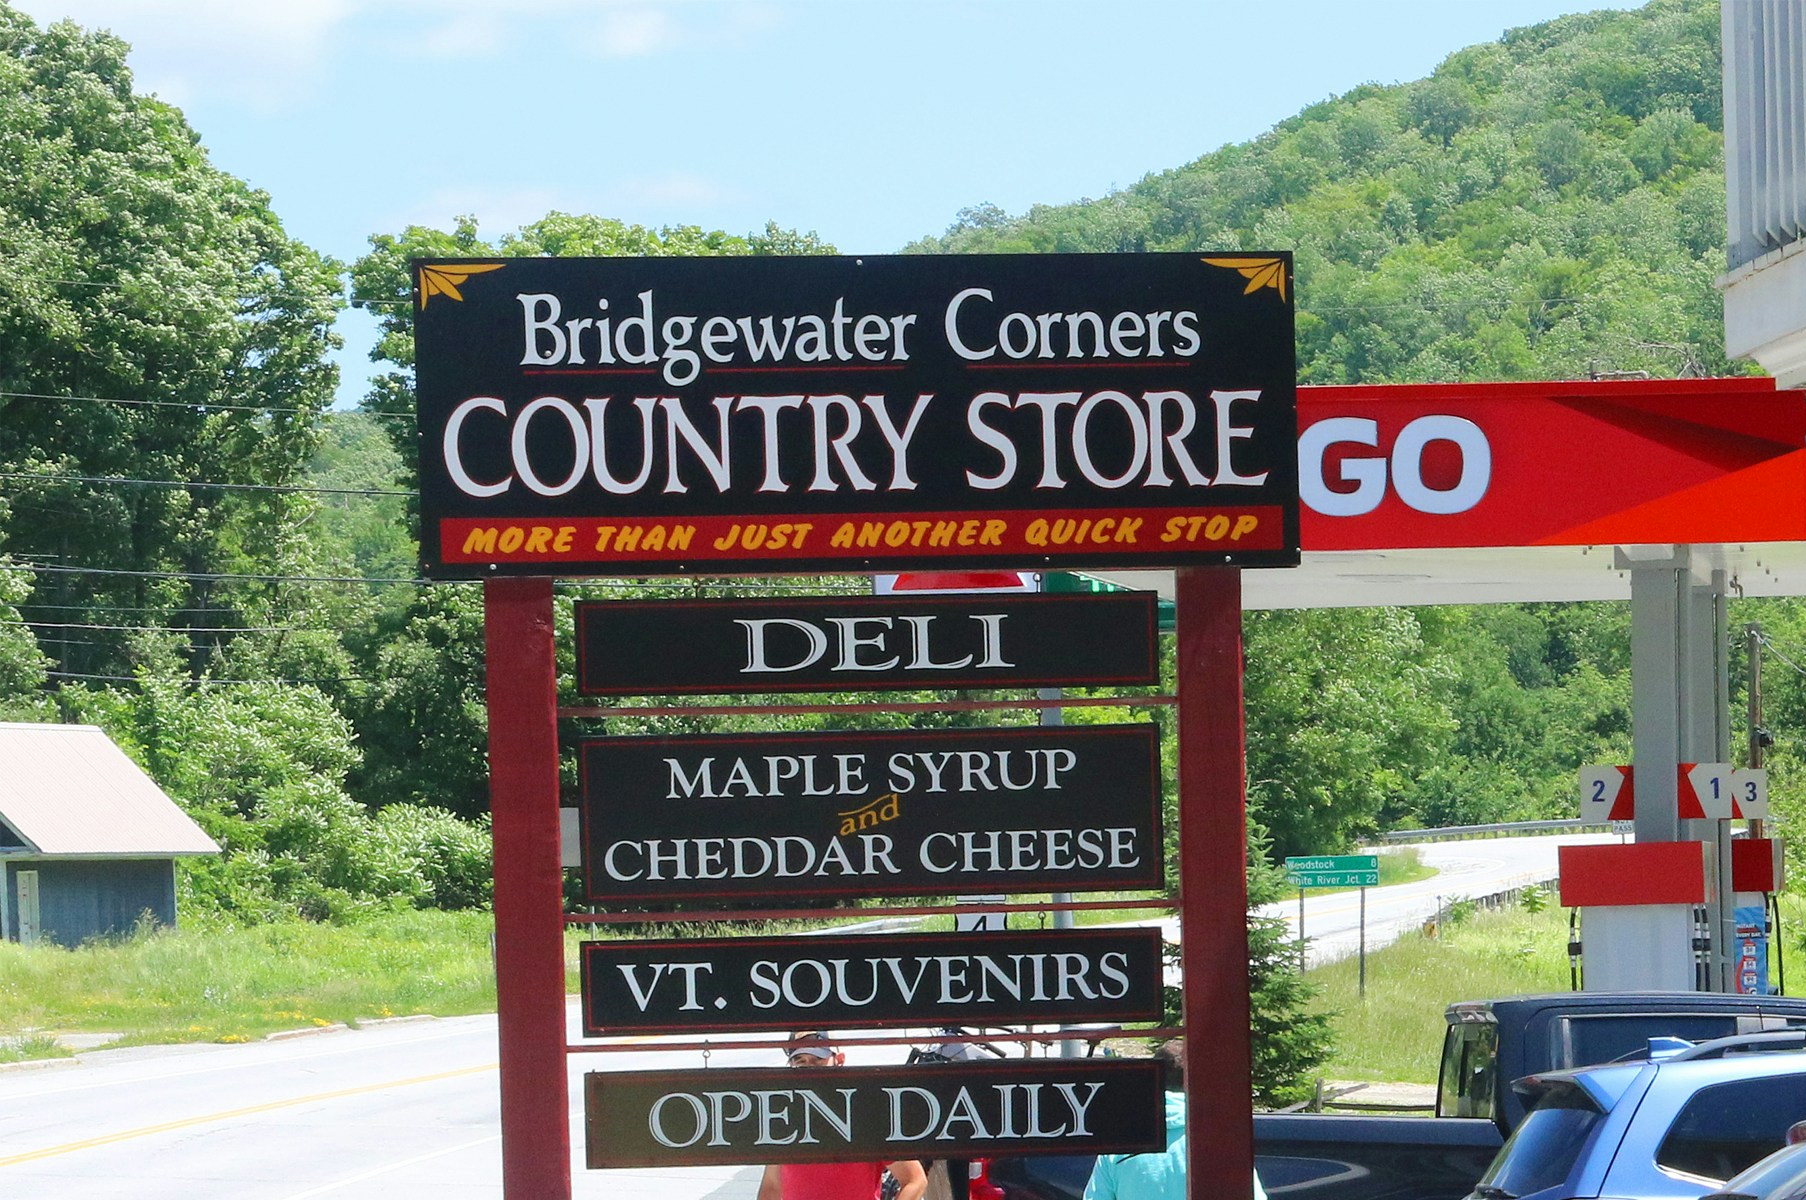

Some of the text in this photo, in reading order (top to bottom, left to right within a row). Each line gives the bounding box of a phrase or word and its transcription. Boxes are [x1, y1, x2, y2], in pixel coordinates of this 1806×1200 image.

[517, 287, 1201, 387] Bridgewater Corners
[443, 390, 1269, 498] COUNTRY STORE
[1298, 415, 1491, 517] GO
[462, 515, 1259, 555] MORE THAN JUST ANOTHER QUICK STOP
[733, 614, 1016, 673] DELI
[662, 749, 1077, 800] MAPLE SYRUP
[1592, 780, 1606, 802] 2
[1710, 777, 1720, 799] 1
[1745, 781, 1758, 802] 3
[838, 794, 901, 837] and
[604, 827, 1141, 882] CHEDDAR CHEESE
[1317, 875, 1341, 885] River
[1366, 874, 1377, 884] 22
[1370, 858, 1377, 868] 8
[615, 952, 1130, 1012] VT. SOUVENIRS
[648, 1082, 1105, 1149] OPEN DAILY
